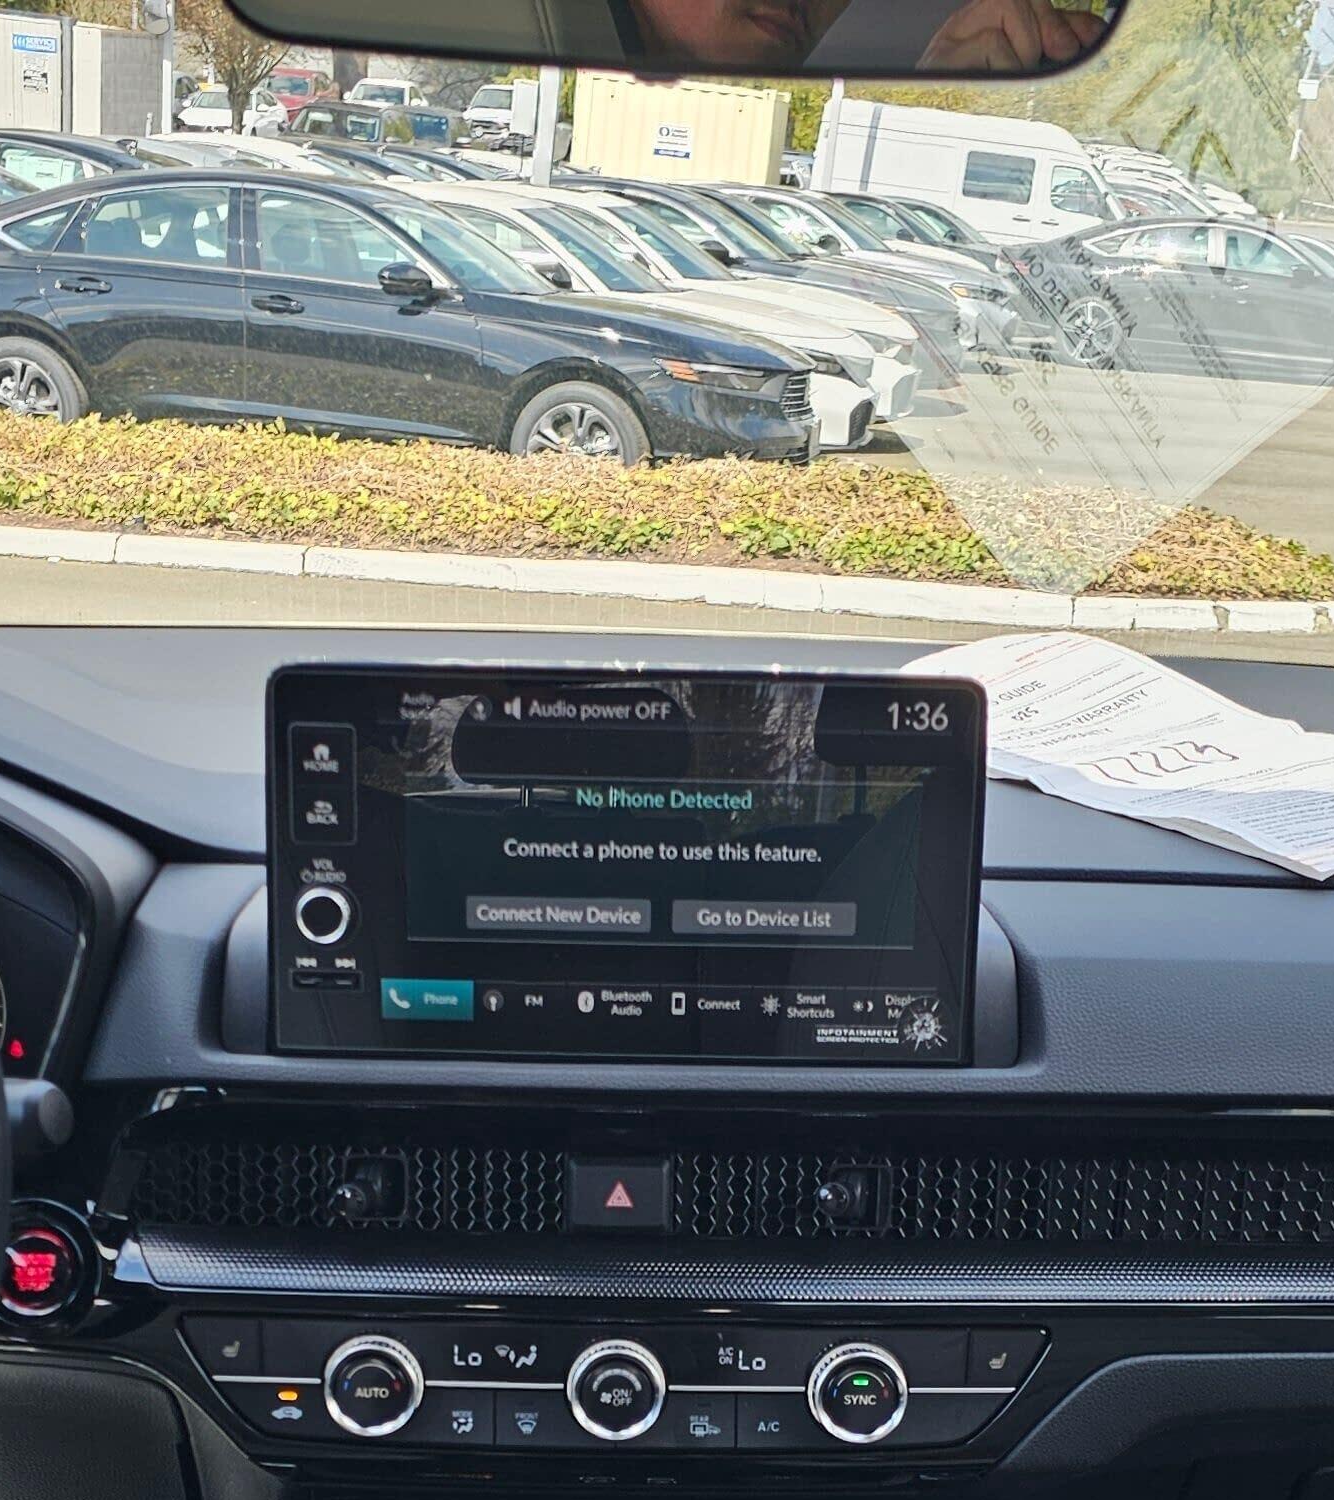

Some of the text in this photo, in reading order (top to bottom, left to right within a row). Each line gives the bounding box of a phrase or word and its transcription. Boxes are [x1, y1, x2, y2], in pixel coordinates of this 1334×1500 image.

[998, 680, 1046, 702] GUIDE
[529, 702, 671, 722] Audio power OFF
[887, 702, 949, 731] 1:36
[576, 787, 753, 810] No Phone Detected
[504, 838, 822, 864] Connect a phone to use this feature.
[476, 905, 641, 925] Connect New Device
[697, 909, 832, 928] Go to Device List
[424, 992, 459, 1006] Phone
[525, 995, 543, 1007] FM
[601, 991, 653, 1004] Bluetooth
[797, 993, 826, 1006] Smart
[885, 994, 916, 1008] Displ
[611, 1005, 643, 1017] Audio
[697, 999, 741, 1011] Connect
[787, 1007, 835, 1019] Shortcuts
[817, 1028, 899, 1037] INFOTAINMENT
[453, 1344, 482, 1366] Lo
[719, 1356, 733, 1365] ON
[738, 1350, 766, 1371] Lo
[355, 1388, 389, 1399] AUTO
[613, 1398, 632, 1408] OFF
[844, 1395, 877, 1406] SYNC
[515, 1411, 539, 1419] FRONT
[757, 1422, 780, 1433] A/C
